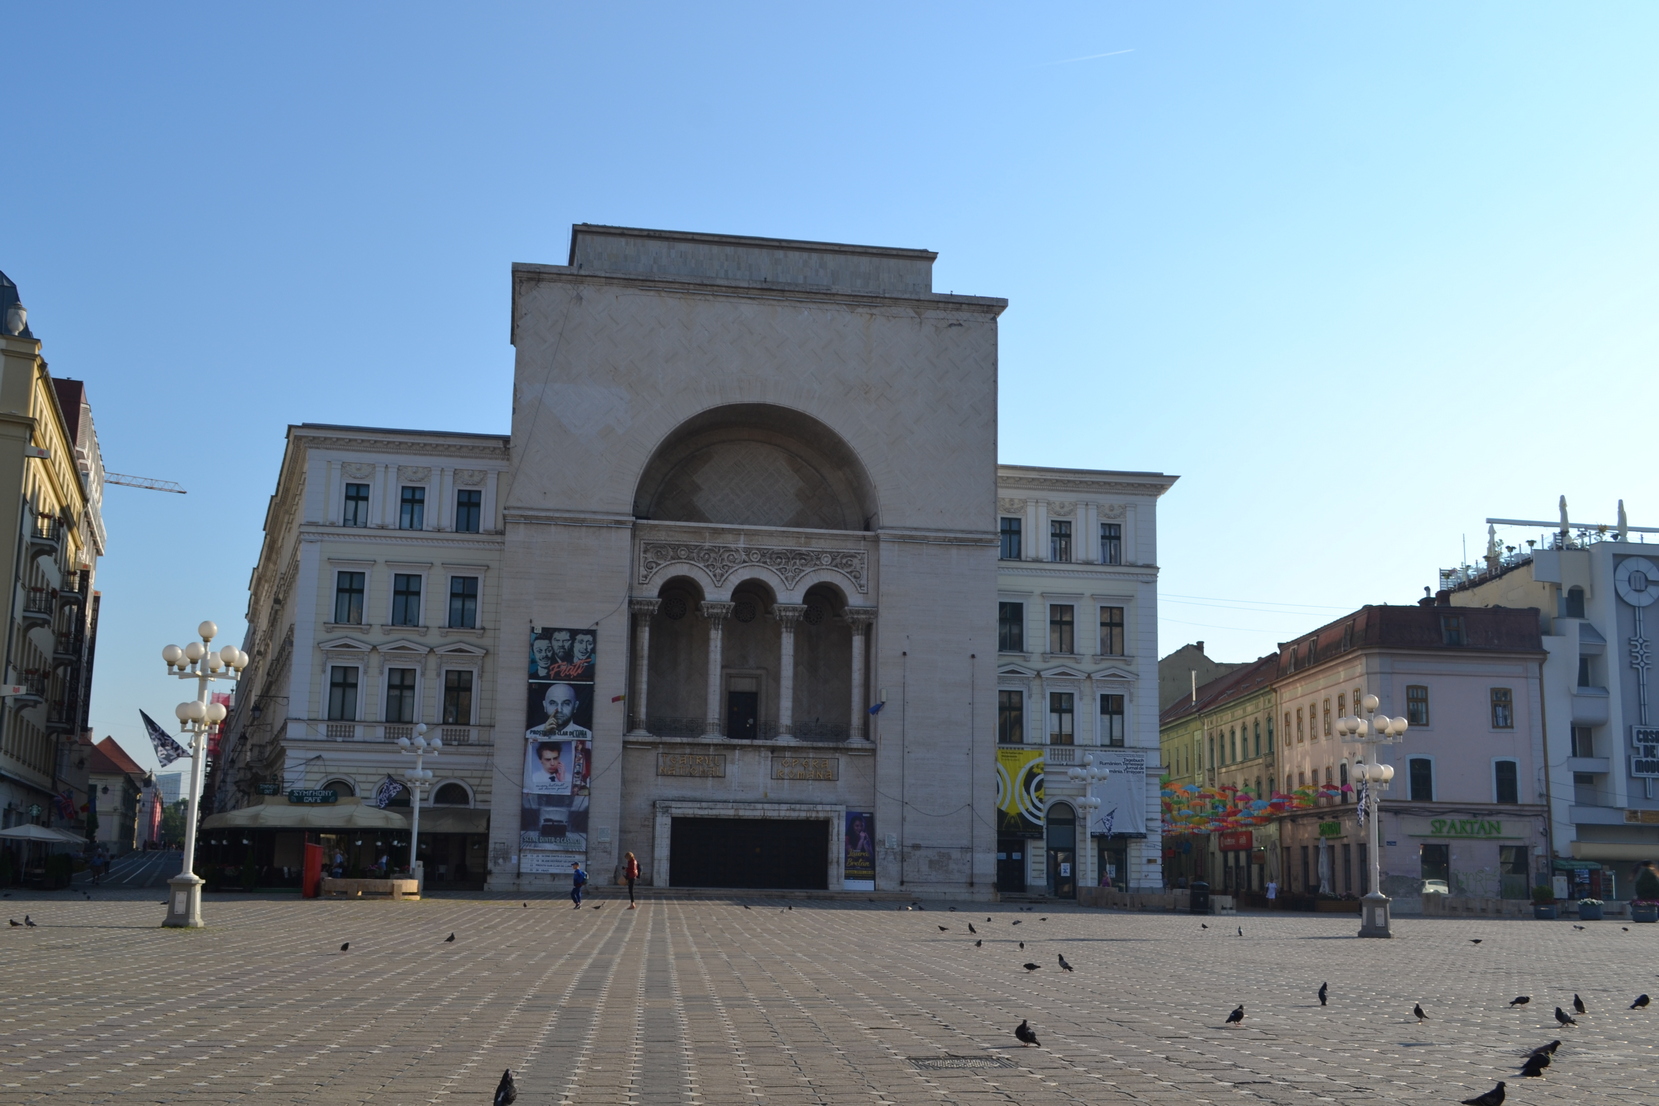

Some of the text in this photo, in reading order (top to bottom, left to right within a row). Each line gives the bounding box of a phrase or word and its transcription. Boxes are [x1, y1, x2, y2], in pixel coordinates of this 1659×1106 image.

[1643, 745, 1656, 758] DE
[781, 758, 829, 768] OPERA
[1431, 819, 1502, 834] SPARTAN
